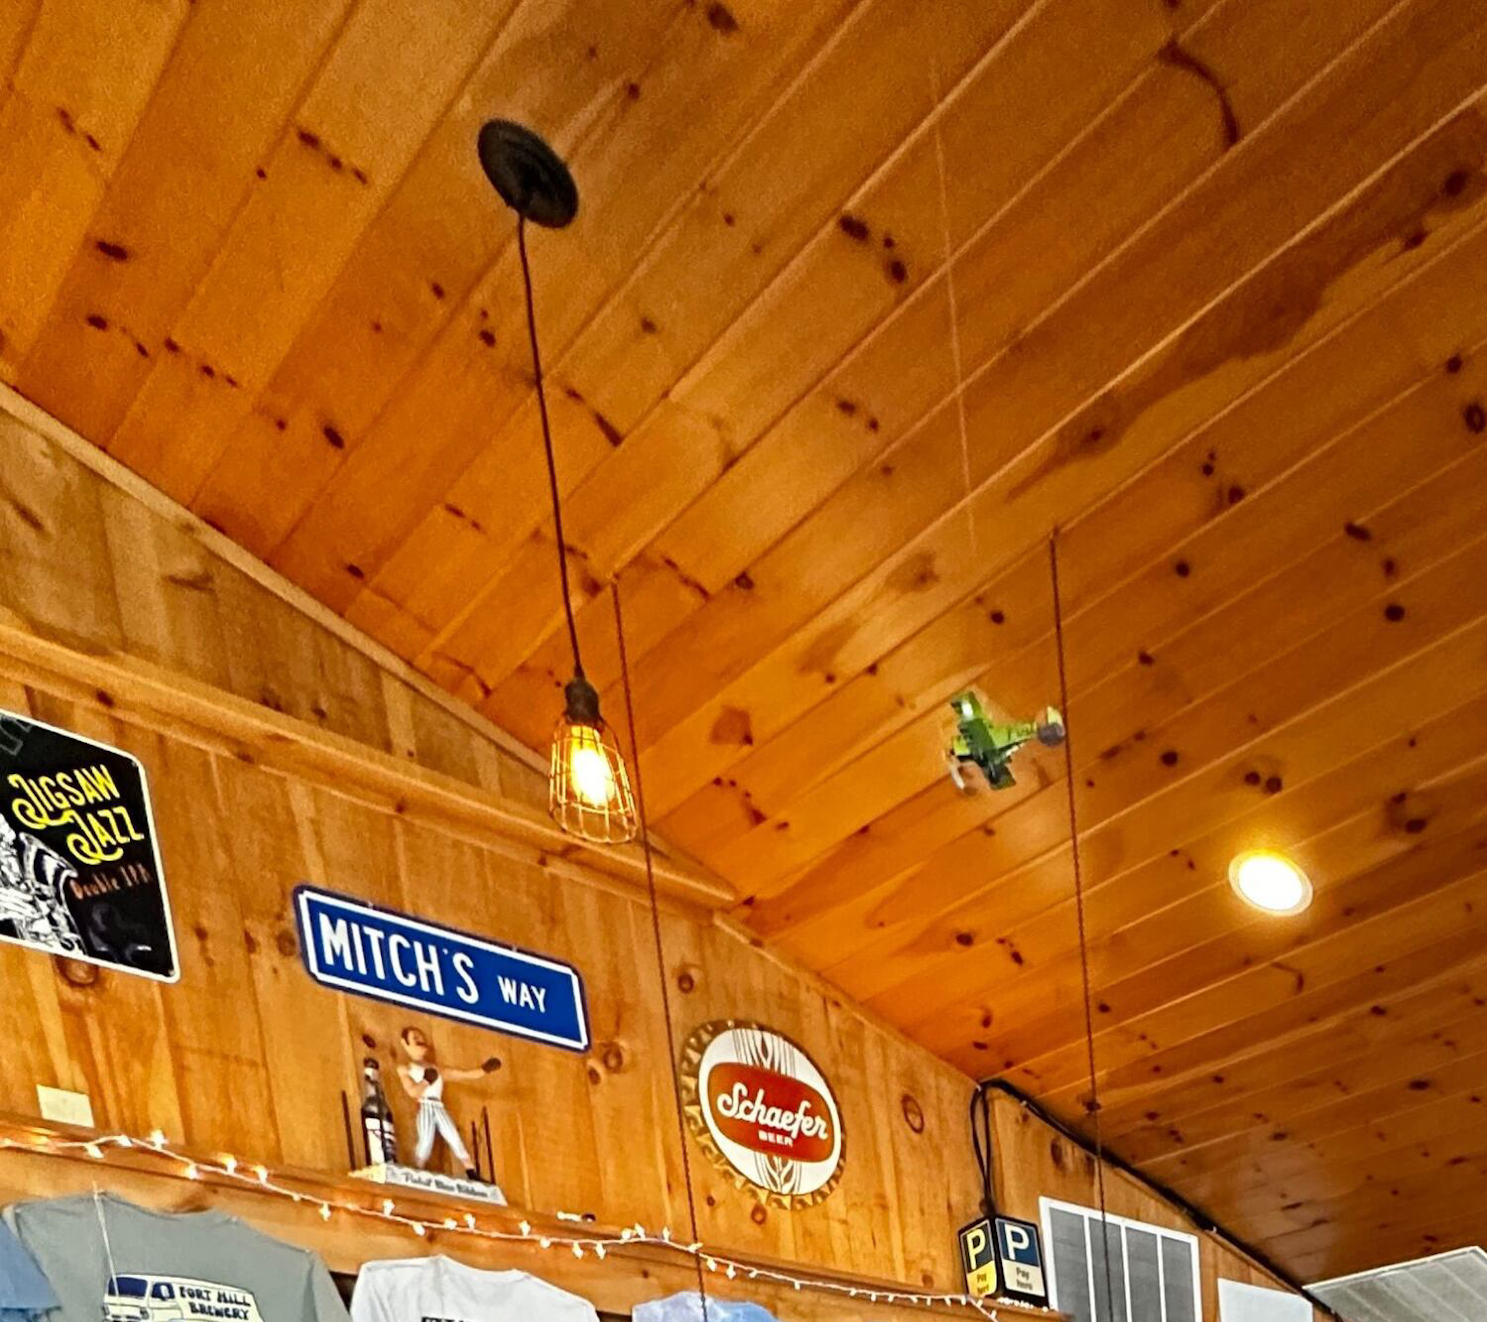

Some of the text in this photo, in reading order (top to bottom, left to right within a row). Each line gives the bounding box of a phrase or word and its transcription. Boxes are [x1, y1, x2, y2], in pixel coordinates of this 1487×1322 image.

[8, 764, 120, 829] JIGSAW
[66, 805, 144, 865] JAZZ
[319, 912, 547, 1013] MITCH'S WAY
[717, 1081, 828, 1140] Schaefer
[758, 1130, 794, 1147] BEER
[966, 1228, 986, 1270] P
[1004, 1223, 1030, 1260] P
[180, 1286, 212, 1302] FORT
[189, 1302, 250, 1321] BREWERY
